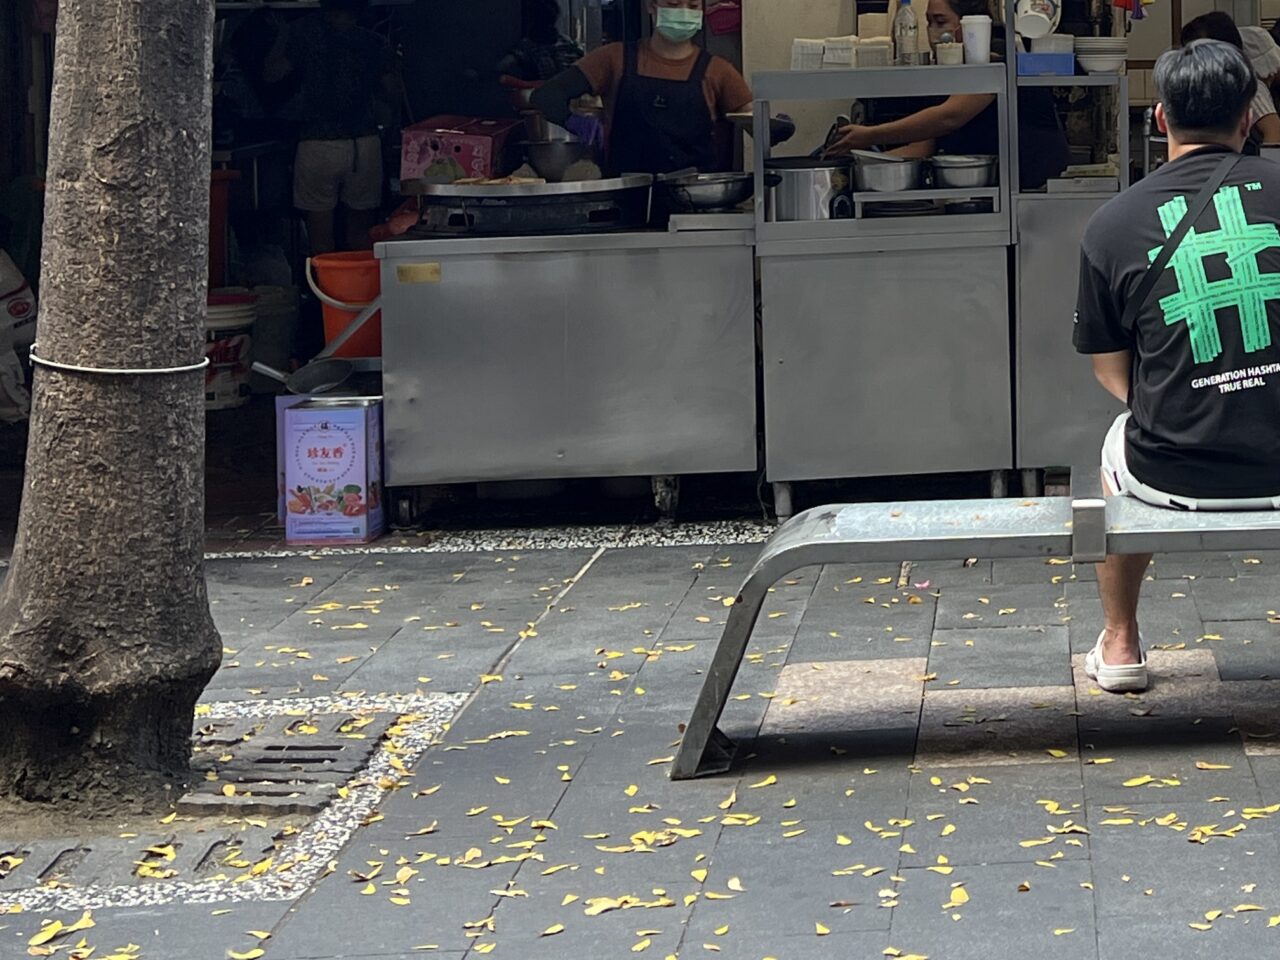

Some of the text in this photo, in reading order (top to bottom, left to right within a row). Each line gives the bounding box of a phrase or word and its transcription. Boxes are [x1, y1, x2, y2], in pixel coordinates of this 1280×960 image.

[1191, 368, 1247, 389] GENERATION
[1218, 377, 1266, 394] TRUE REAL
